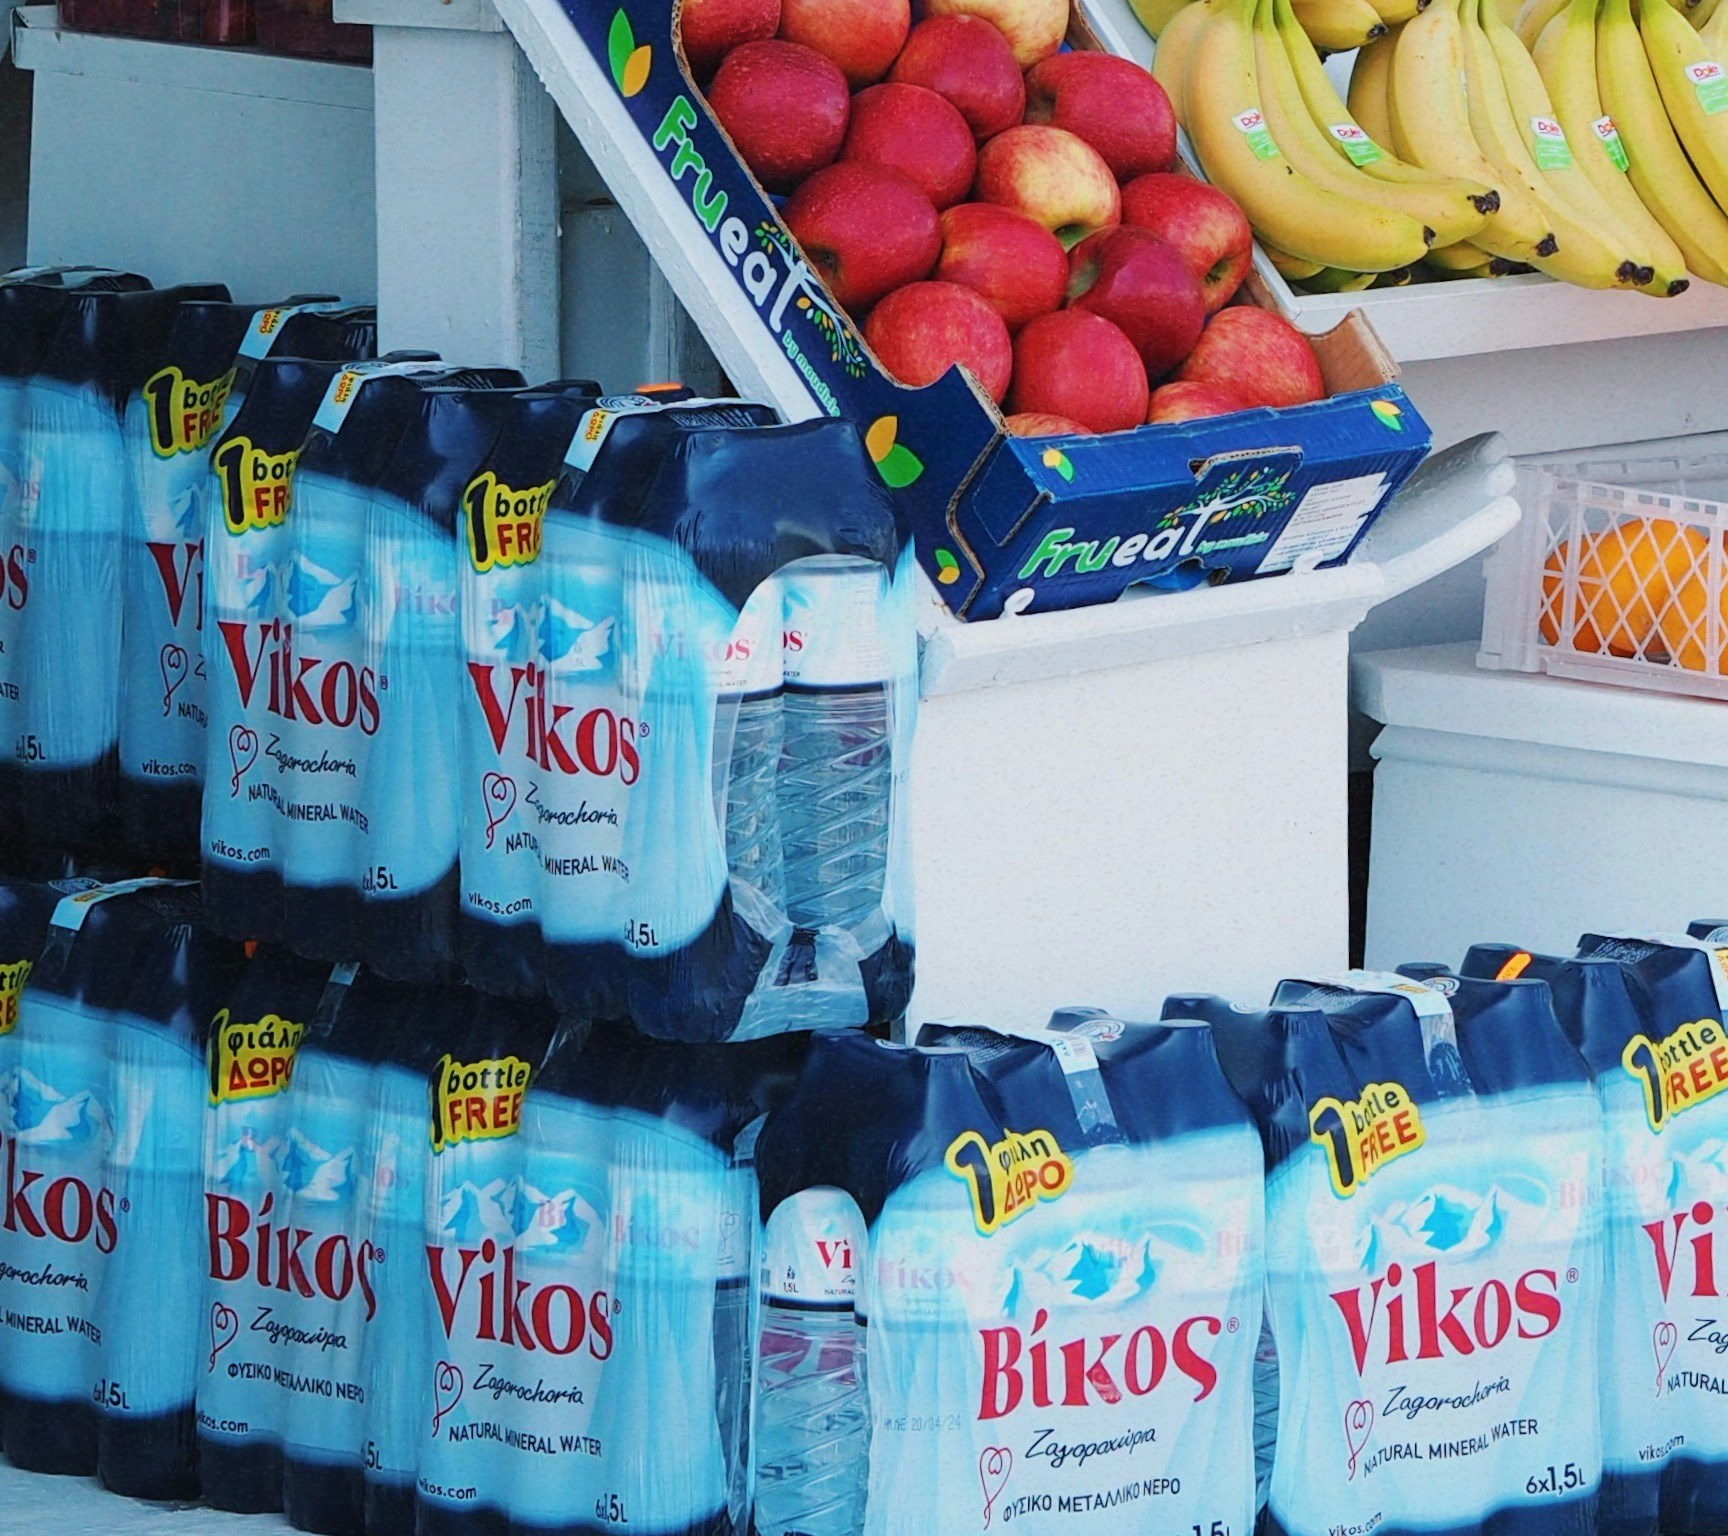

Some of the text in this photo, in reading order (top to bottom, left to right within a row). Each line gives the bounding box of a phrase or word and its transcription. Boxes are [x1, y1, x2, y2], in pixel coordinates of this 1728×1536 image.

[1694, 64, 1719, 78] Dole
[1337, 127, 1363, 138] Dole
[1538, 121, 1560, 133] Dole
[652, 94, 810, 334] Frueat
[148, 373, 175, 449] 1
[219, 444, 244, 525] 1
[254, 484, 290, 519] FR
[495, 486, 550, 518] bott
[467, 480, 488, 563] 1
[1017, 500, 1217, 580] Frueat
[217, 618, 381, 737] Vikos
[468, 660, 641, 786] Vikos
[264, 732, 357, 778] Zagorochoria
[248, 784, 369, 834] NATURAL MINERAL WATER
[524, 780, 619, 828] Zagorochoria
[211, 839, 271, 862] vikos.com
[505, 832, 630, 881] NATURAL MINERAL WATER
[468, 891, 532, 916] vikos.com
[209, 1016, 225, 1096] 1
[228, 1056, 294, 1092] ΔΩΡΟ
[447, 1063, 527, 1096] bottle
[427, 1059, 446, 1144] 1
[1631, 1043, 1663, 1124] 1
[448, 1093, 522, 1134] FREE
[1352, 1089, 1401, 1136] bottle
[1314, 1107, 1354, 1188] 1
[1359, 1109, 1418, 1175] FREE
[3, 1139, 118, 1255] kos
[956, 1139, 997, 1227] 1
[1004, 1159, 1066, 1211] ΔΩΡΟ
[0, 1263, 89, 1292] gorochoria
[204, 1191, 376, 1322] Βίκος
[426, 1238, 613, 1361] Vikos
[1329, 1260, 1562, 1377] Vikos
[6, 1312, 102, 1347] MINERAL WATER
[227, 1361, 365, 1404] ΦΥΣΙΚΟ ΜΕΤΑΛΛΙΚΟ ΝΕΡΟ
[473, 1364, 584, 1405] Zagorochoria
[977, 1308, 1222, 1421] Βίκος
[1382, 1375, 1511, 1420] Zagorochoria
[196, 1412, 249, 1433] ikos.com
[448, 1422, 602, 1459] NATURAL MINERAL WATER
[1025, 1426, 1157, 1469] Ζαγοροχώρια
[1363, 1419, 1539, 1479] NATURAL MINERAL WATER
[1003, 1477, 1181, 1523] ΦΥΣΙΚΟ ΜΕΤΑΛΛΙΚΟ ΝΕΡΟ
[1525, 1463, 1586, 1497] 6x1,5L
